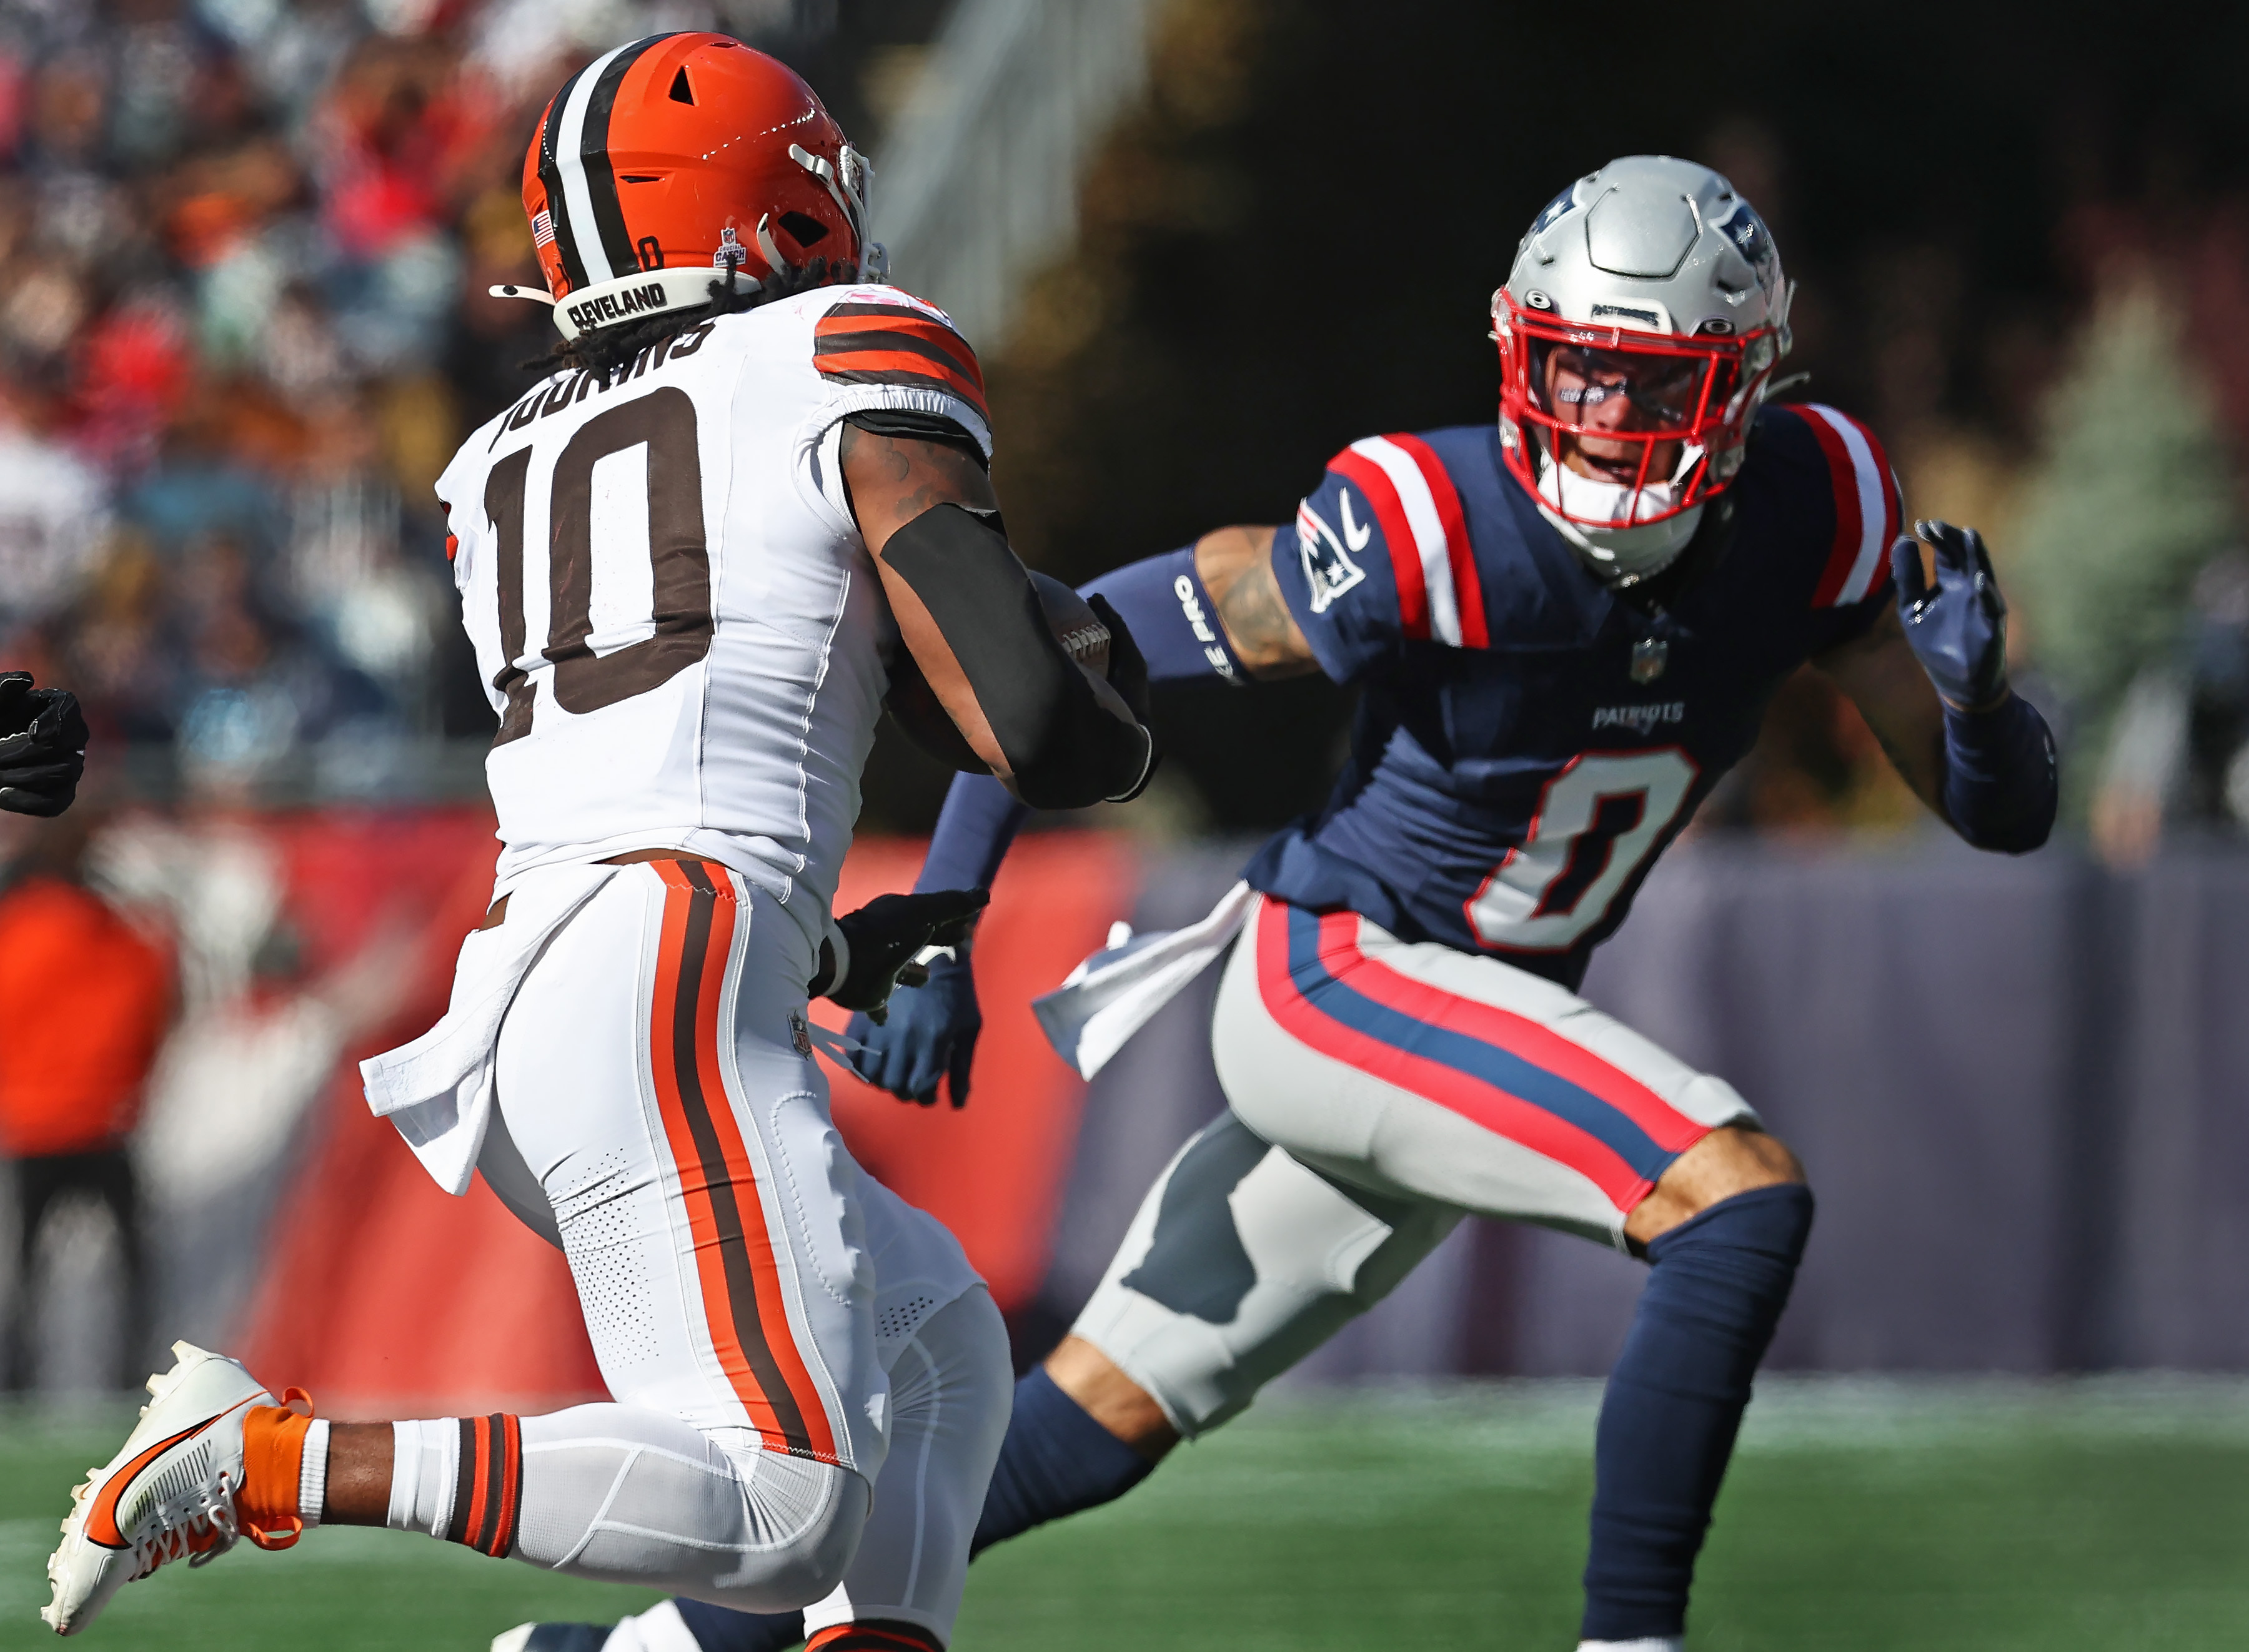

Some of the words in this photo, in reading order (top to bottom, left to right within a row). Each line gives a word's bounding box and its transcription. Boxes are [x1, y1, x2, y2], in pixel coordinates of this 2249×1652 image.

[567, 282, 668, 329] CLEVELAND
[484, 385, 715, 747] 10
[1174, 575, 1216, 642] PRO
[1463, 744, 1701, 954] 0
